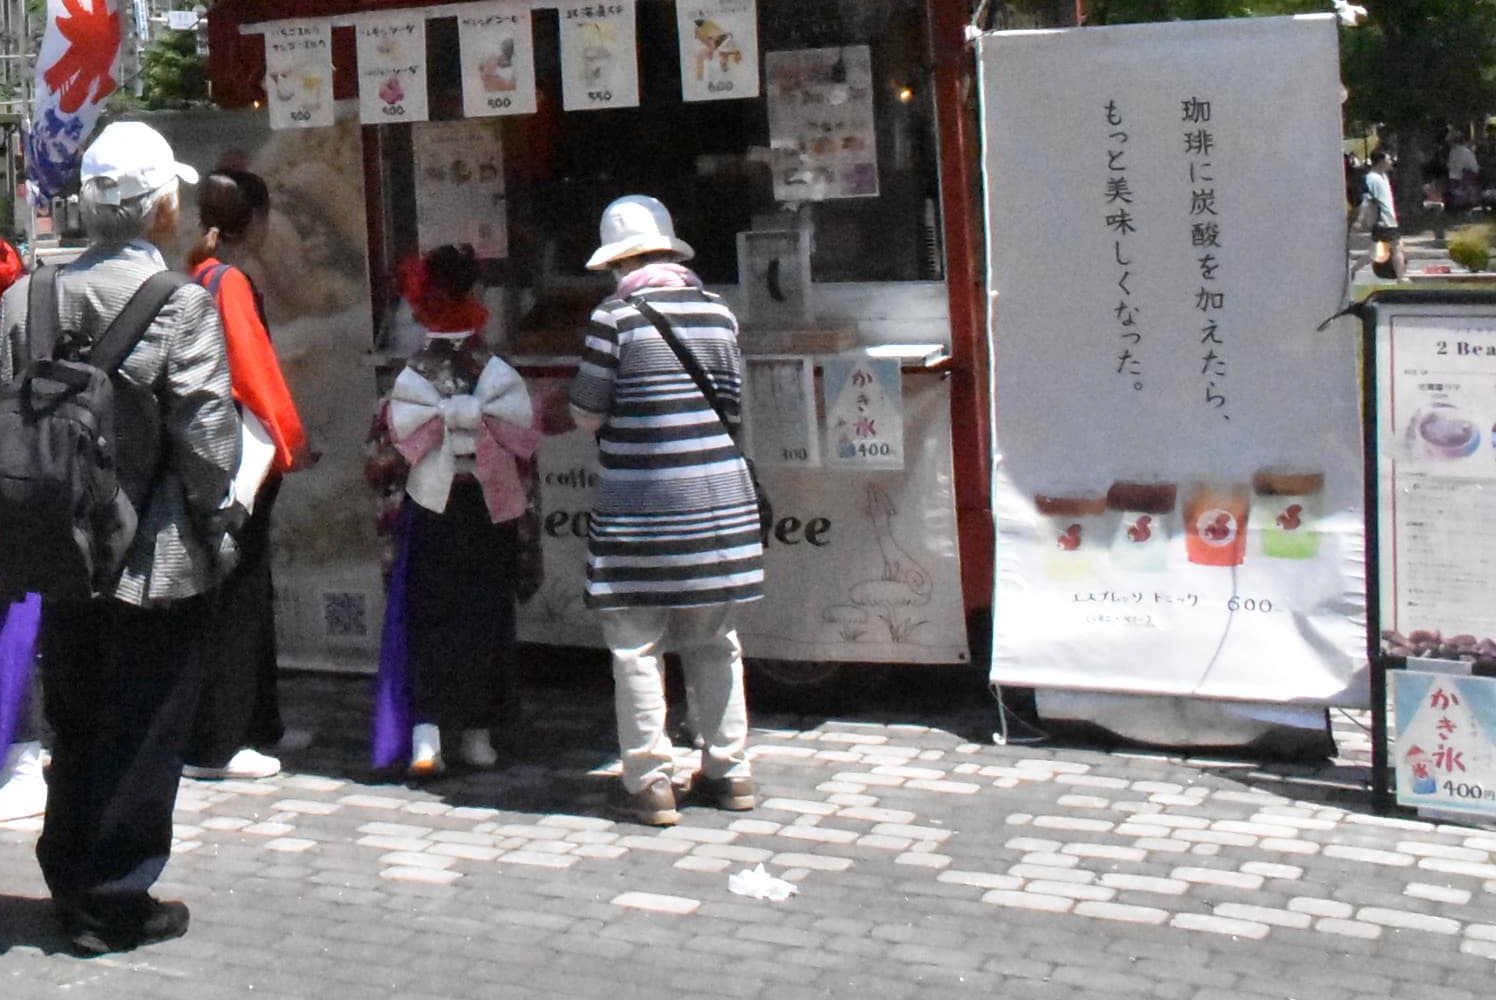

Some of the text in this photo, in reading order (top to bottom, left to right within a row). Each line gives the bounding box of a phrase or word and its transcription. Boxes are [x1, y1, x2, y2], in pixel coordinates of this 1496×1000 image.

[1103, 99, 1145, 392] もっと美味しくなった。
[1181, 96, 1231, 420] 珈琲に炭酸を加えたら、
[1436, 341, 1448, 356] 2
[857, 442, 891, 458] 400
[1431, 687, 1467, 773] かき氷
